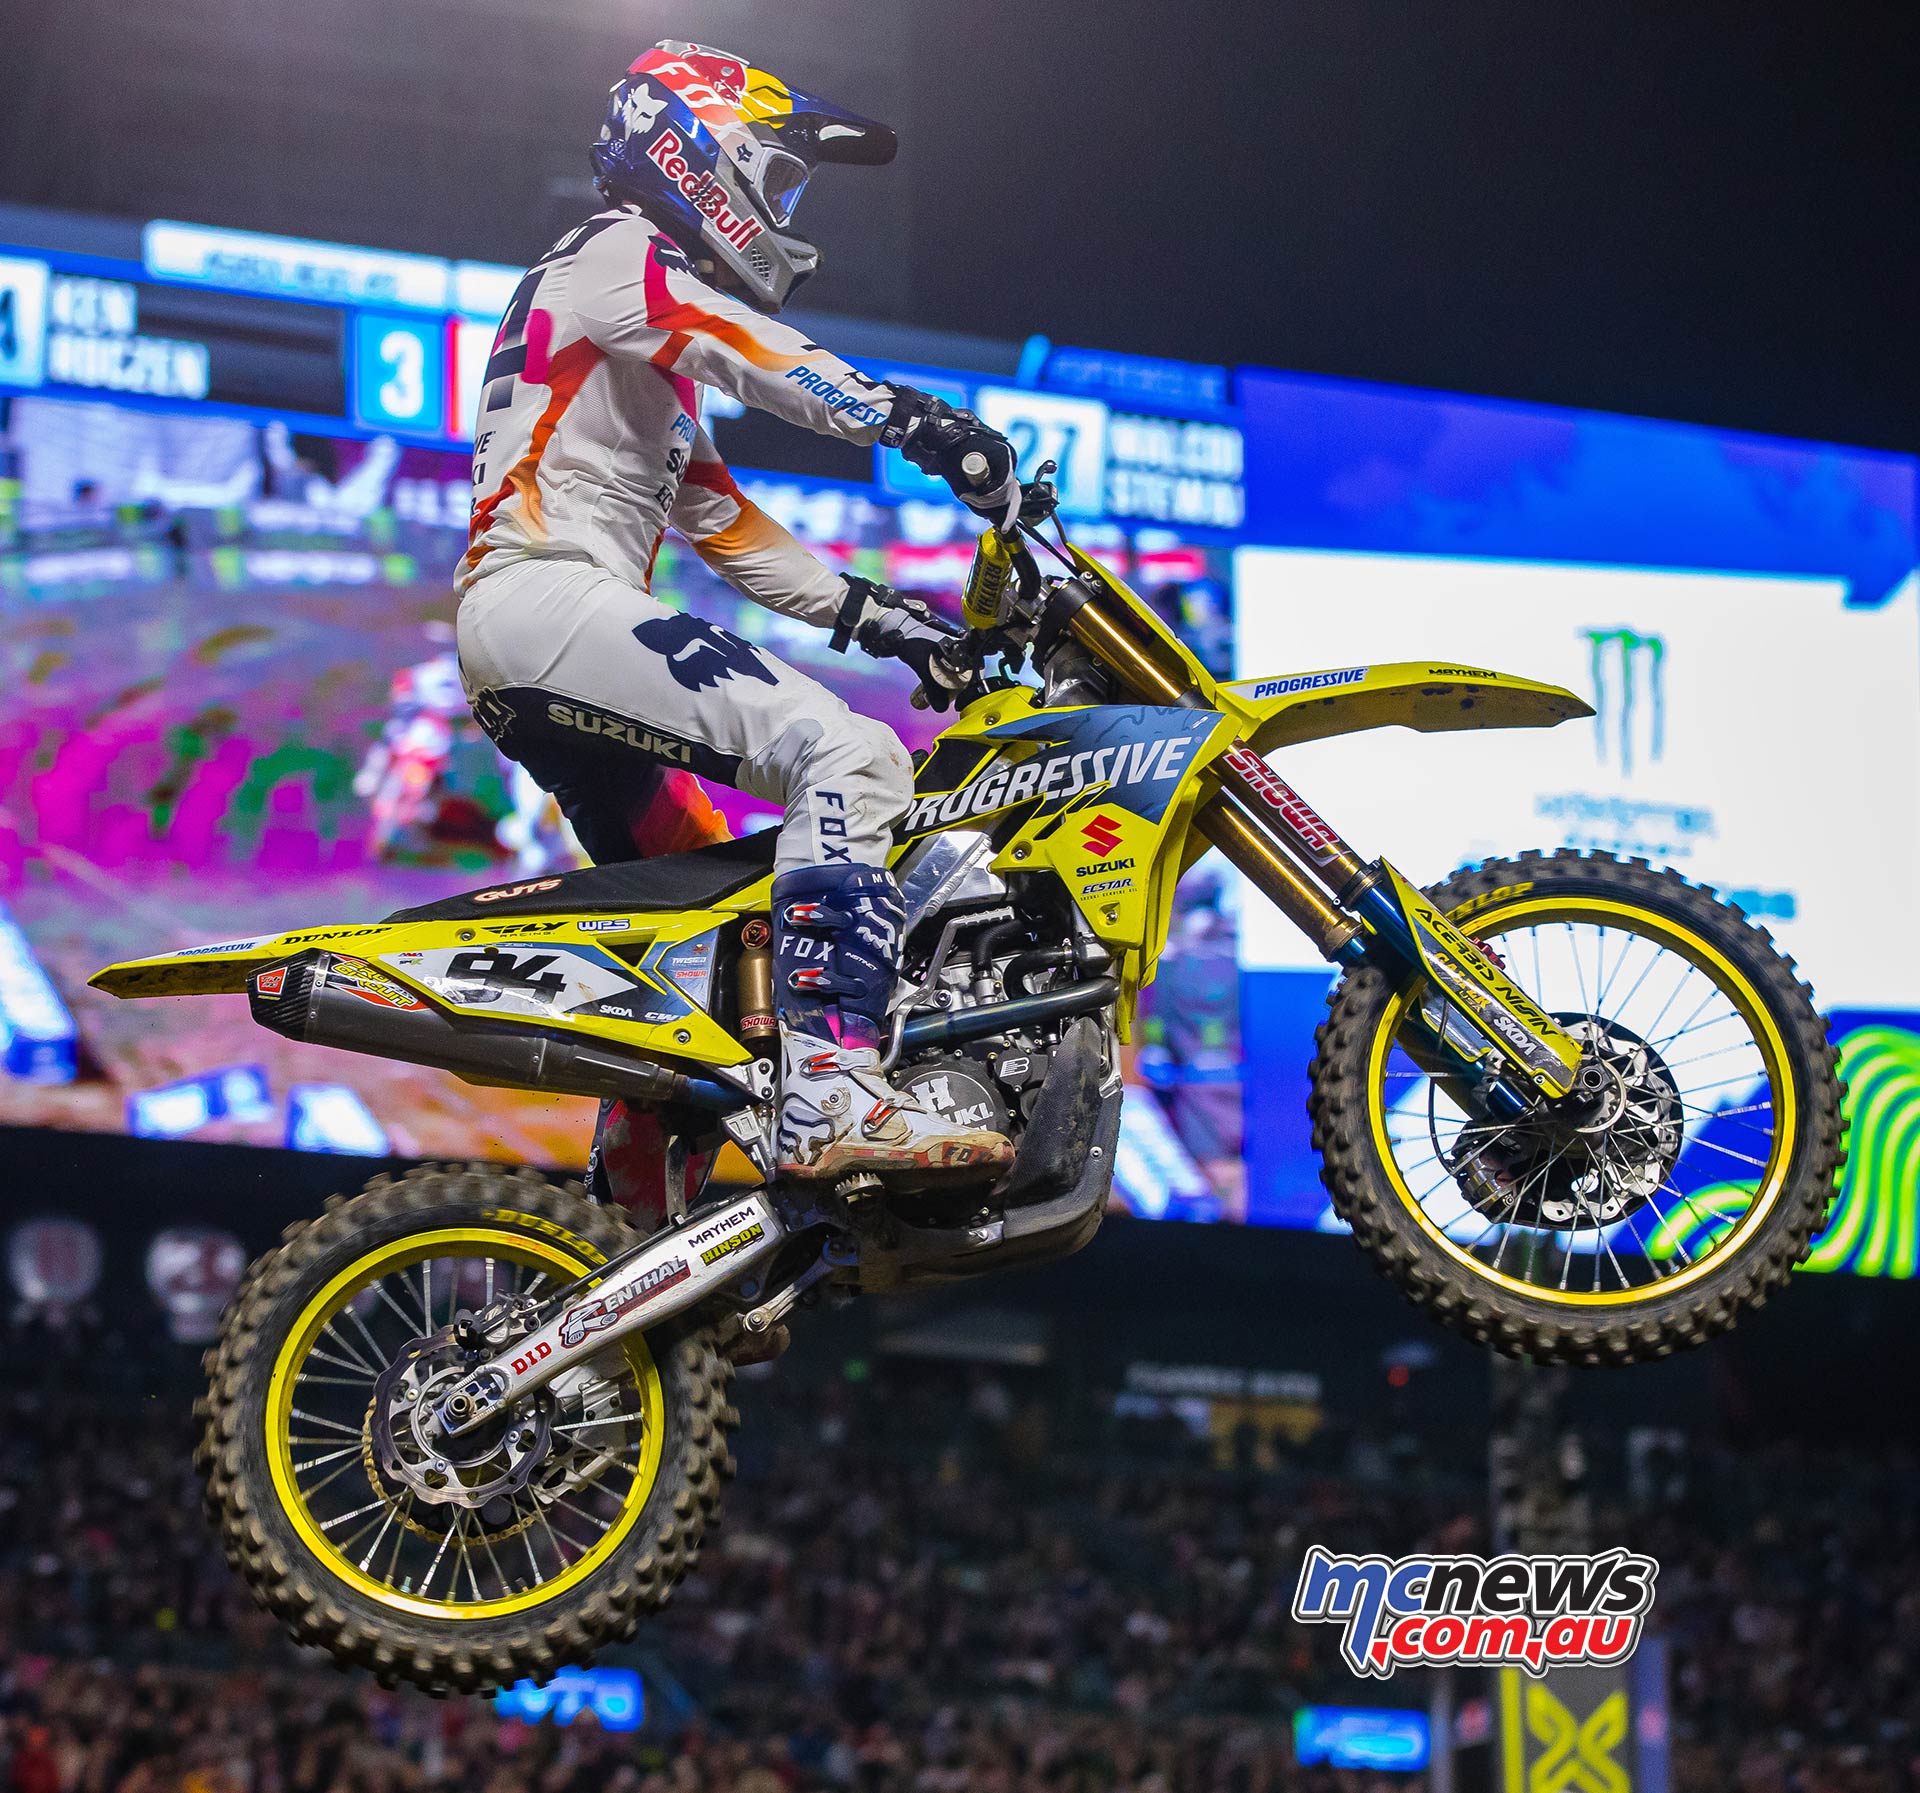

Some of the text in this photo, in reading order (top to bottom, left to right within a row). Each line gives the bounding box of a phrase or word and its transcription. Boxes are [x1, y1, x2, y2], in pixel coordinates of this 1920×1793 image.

[377, 330, 425, 419] 3
[1254, 668, 1366, 698] PROGRESSIVE
[1428, 668, 1498, 680] MAYHEM
[547, 702, 692, 764] SUZUKI
[902, 736, 1192, 832] ROGRESSIVE
[1223, 748, 1341, 851] SHOWA
[815, 790, 851, 863] FOX
[1076, 857, 1135, 877] SUZUKI
[473, 878, 564, 902] GUTS
[1082, 878, 1133, 894] ECSTAR
[281, 926, 393, 946] DUNLOP
[577, 918, 631, 932] WPS
[779, 935, 835, 962] FOX
[1415, 907, 1495, 982] ACERBIS
[675, 970, 707, 979] SHOWA
[845, 951, 879, 972] INSTINCT
[445, 952, 568, 1005] 94
[600, 1004, 634, 1018] SKDA
[740, 1014, 780, 1031] SHOWA
[1494, 986, 1559, 1036] NISSIN
[1493, 1015, 1538, 1056] SKDA
[687, 1206, 756, 1248] MAYHEM
[700, 1222, 765, 1266] HINSON
